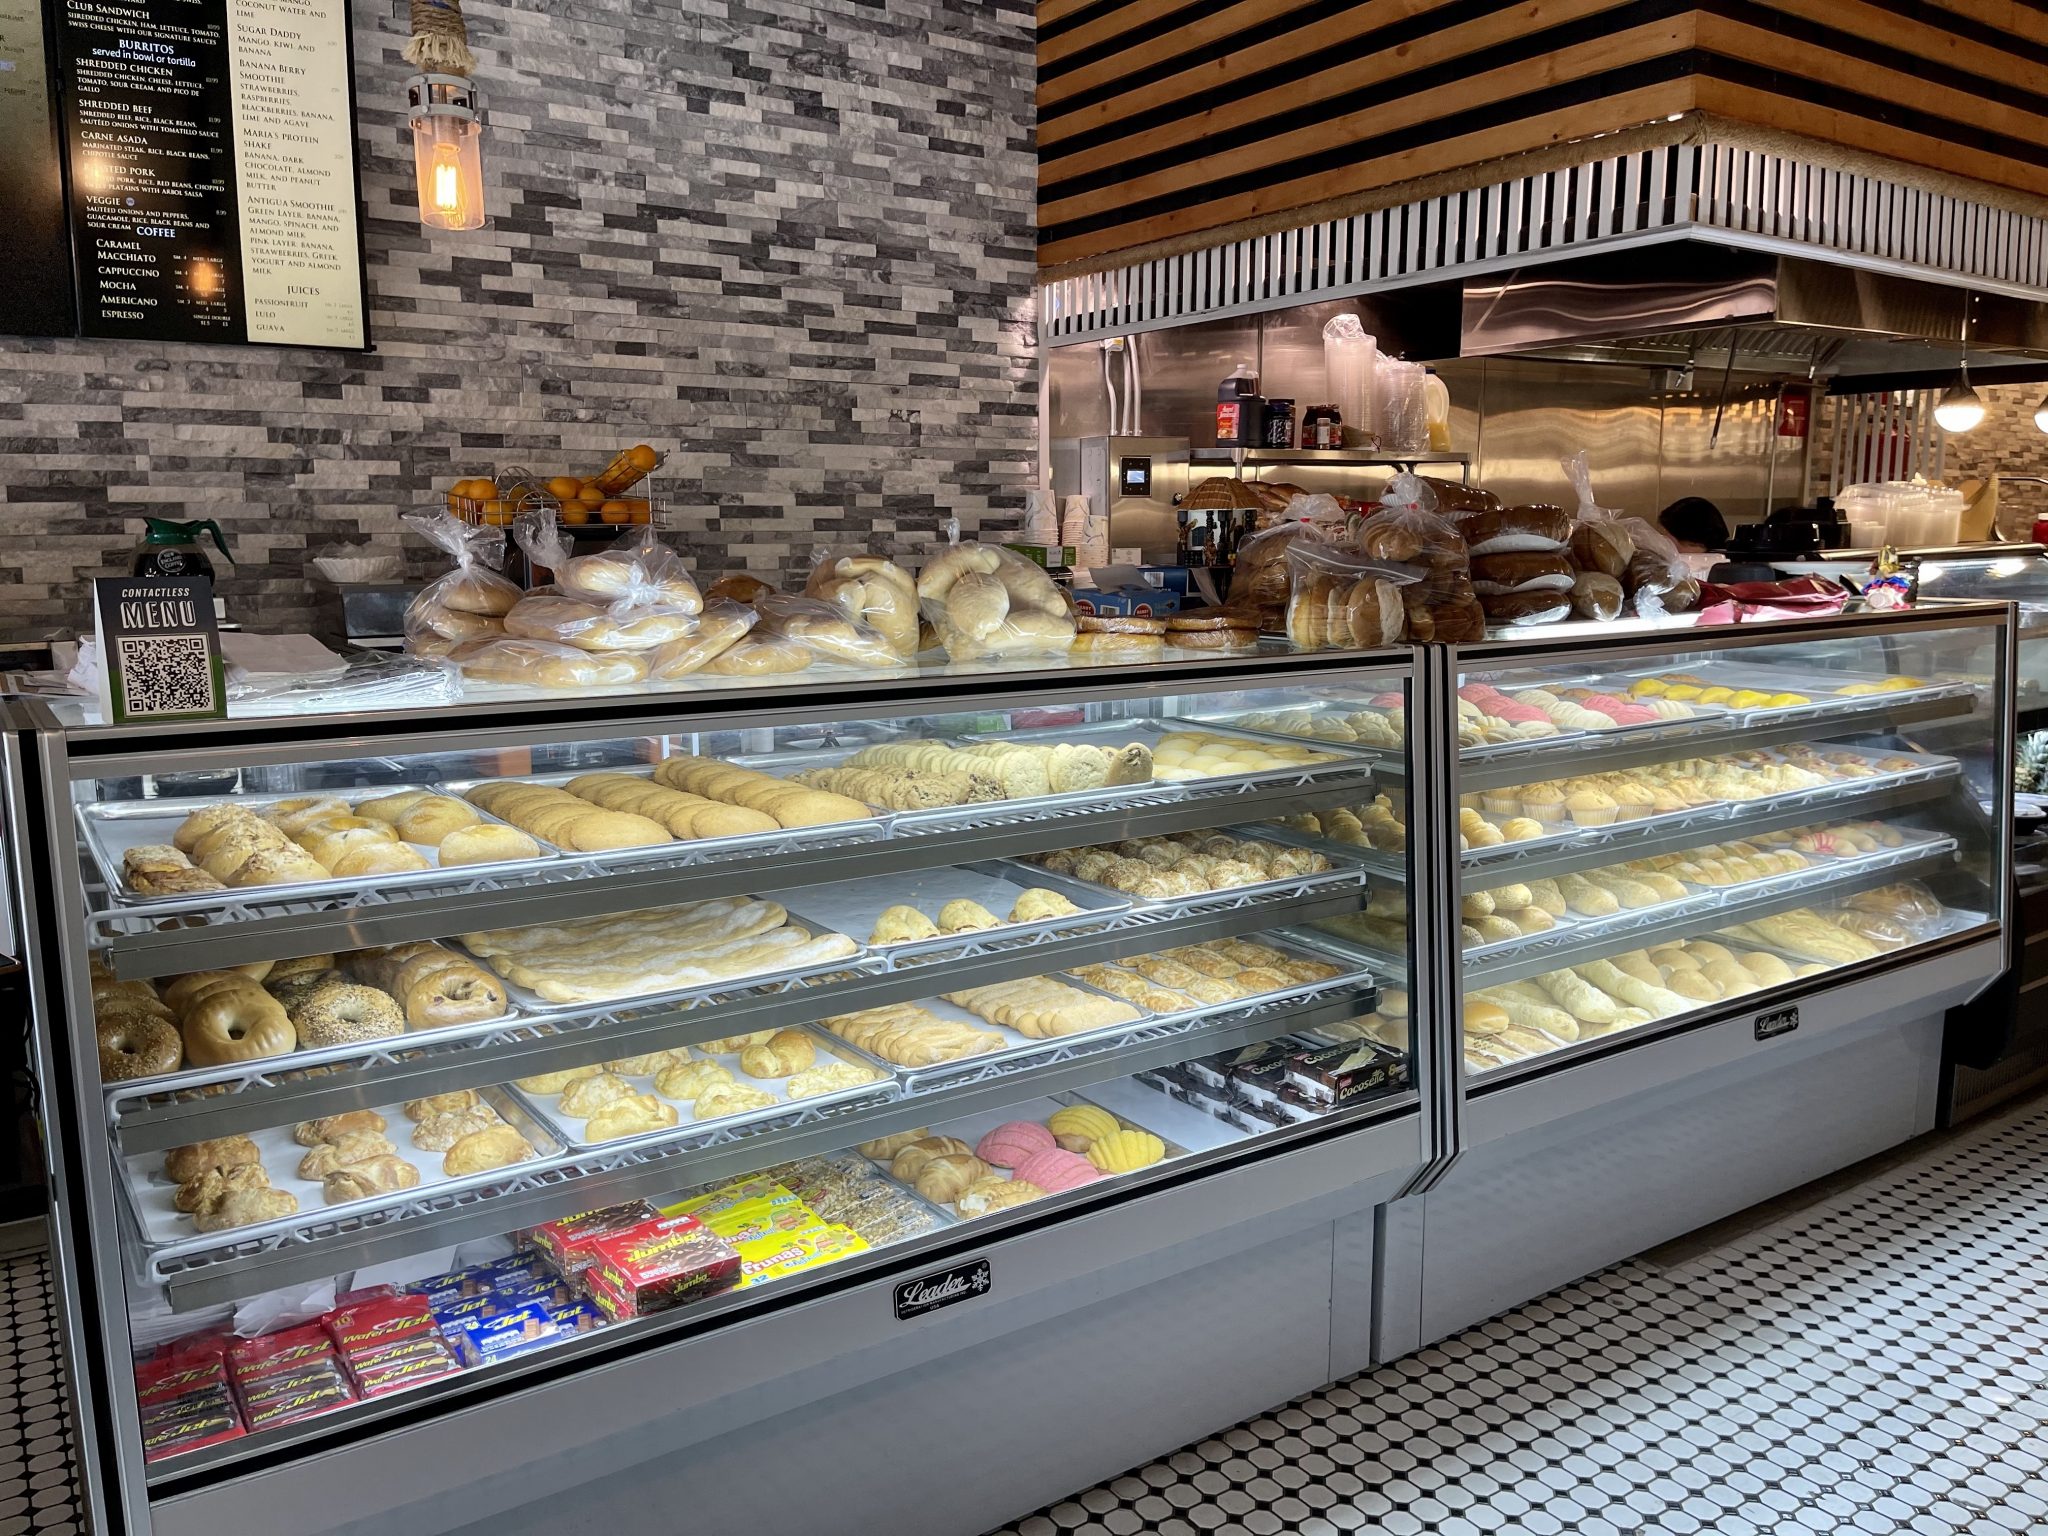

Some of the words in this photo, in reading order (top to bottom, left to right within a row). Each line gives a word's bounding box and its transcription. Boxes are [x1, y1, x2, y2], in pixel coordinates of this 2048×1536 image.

[67, 0, 93, 12] CLUB
[96, 4, 150, 19] SANDWICH
[236, 0, 276, 11] COCONUT
[279, 6, 306, 16] WATER
[310, 10, 327, 19] AND
[236, 10, 254, 18] LIME
[68, 12, 104, 22] SHREDDED
[68, 20, 88, 28] SWISS
[90, 23, 114, 32] CHEESE
[117, 27, 135, 35] WITH
[154, 31, 191, 42] SIGNATURE
[193, 36, 216, 45] SAUCES
[237, 24, 267, 35] SUGAR
[270, 28, 301, 40] DADDY
[119, 39, 174, 55] BURRITOS
[238, 46, 272, 57] BANANA
[298, 44, 315, 52] AND
[92, 48, 120, 58] served
[123, 50, 130, 59] in
[133, 51, 154, 62] bowl
[168, 55, 196, 67] tortilla
[76, 57, 127, 71] SHREDDED
[130, 64, 173, 77] CHICKEN
[240, 59, 276, 71] BANANA
[280, 65, 306, 76] BERRY
[77, 68, 112, 79] SHREDDED
[240, 71, 284, 84] SMOOTHIE
[78, 85, 100, 93] GALLO
[110, 81, 128, 89] SOUR
[157, 86, 172, 94] AND
[174, 88, 189, 96] PICO
[79, 99, 130, 112] SHREDDED
[133, 105, 153, 114] BEEF
[80, 110, 116, 119] SHREDDED
[153, 117, 174, 125] BLACK
[242, 114, 259, 122] LIME
[284, 119, 309, 128] AGAVE
[112, 122, 138, 130] ONIONS
[161, 126, 197, 136] TOMATILLO
[199, 130, 219, 138] SAUCE
[81, 131, 114, 142] CARNE
[117, 135, 148, 145] ASADA
[283, 134, 319, 144] PROTEIN
[82, 142, 122, 151] MARINATED
[167, 150, 187, 158] BLACK
[244, 141, 272, 150] SHAKE
[82, 150, 115, 158] CHIPOTLE
[117, 153, 138, 161] SAUCE
[283, 156, 304, 164] DARK
[130, 167, 156, 177] PORK
[298, 168, 331, 177] ALMOND
[194, 183, 225, 192] CHOPPED
[246, 182, 277, 191] BUTTER
[291, 177, 321, 186] PEANUT
[109, 183, 139, 192] PLATAINS
[142, 186, 160, 194] WITH
[86, 195, 121, 206] VEGGIE
[248, 196, 288, 207] ANTIGUA
[290, 200, 335, 211] SMOOTHIE
[118, 208, 144, 216] ONIONS
[248, 207, 274, 216] GREEN
[151, 218, 171, 226] BLACK
[173, 220, 193, 228] BEANS
[136, 226, 176, 238] COFFEE
[250, 228, 284, 236] ALMOND
[96, 238, 141, 250] CARAMEL
[250, 237, 270, 245] PINK
[97, 251, 156, 263] MACCHIATO
[312, 251, 338, 260] GREEK
[251, 257, 285, 266] YOGURT
[288, 260, 305, 268] AND
[308, 262, 341, 271] ALMOND
[98, 266, 160, 278] CAPPUCCINO
[252, 267, 272, 275] MILK
[100, 280, 137, 291] MOCHA
[287, 285, 320, 296] JUICES
[100, 294, 158, 306] AMERICANO
[254, 298, 308, 308] PASSIONFRUIT
[102, 310, 144, 319] ESPRESSO
[255, 310, 276, 318] LULO
[256, 324, 285, 332] GUAVA
[122, 587, 190, 598] CONTACTLESS
[120, 600, 197, 629] MENU
[1340, 1069, 1385, 1100] Cocosette
[628, 1233, 696, 1262] Jumbo
[742, 1247, 806, 1274] Frunas
[436, 1272, 466, 1288] Jet
[603, 1265, 624, 1288] Jumbo
[528, 1279, 558, 1296] Jet
[674, 1274, 708, 1294] Jumbo
[899, 1274, 971, 1307] Leader
[454, 1298, 488, 1316] Jet
[595, 1291, 616, 1312] Jumbo
[556, 1306, 583, 1322] Jet
[386, 1314, 430, 1333] Jet
[494, 1310, 531, 1331] Jet
[282, 1340, 331, 1362] Jet
[384, 1345, 414, 1360] Jet
[395, 1360, 427, 1375] Jet
[286, 1390, 320, 1409] Jet
